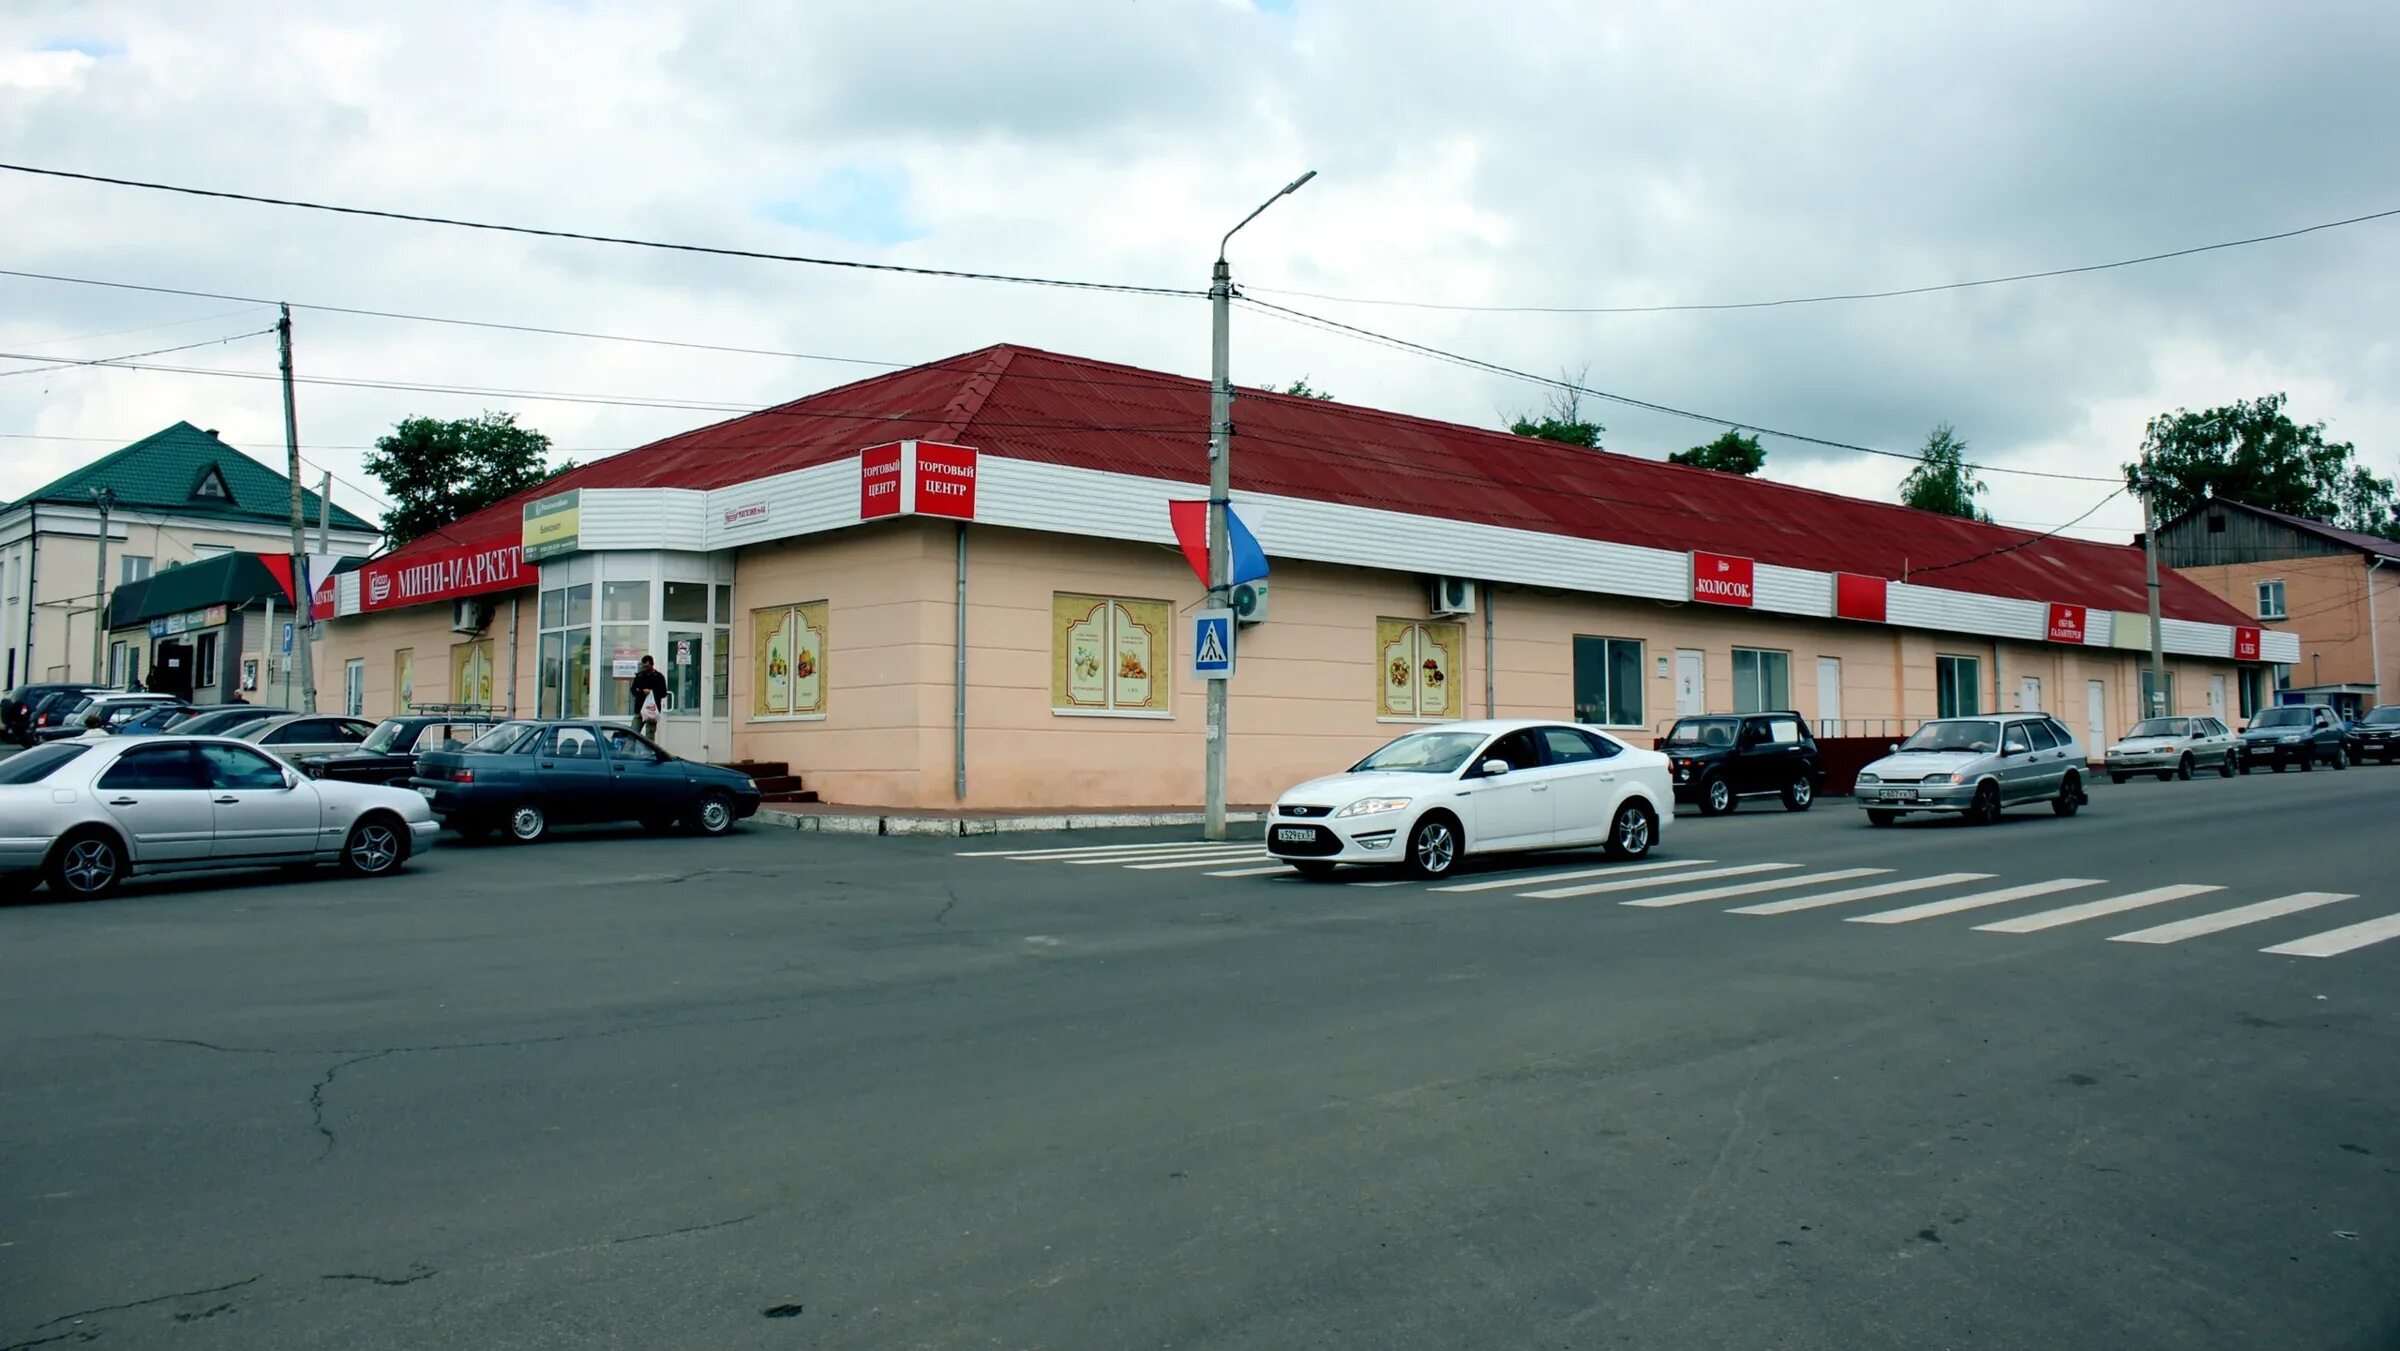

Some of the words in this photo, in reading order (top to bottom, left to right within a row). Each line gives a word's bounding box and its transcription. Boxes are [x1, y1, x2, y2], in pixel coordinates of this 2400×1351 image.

[863, 459, 900, 478] ТОРГОВЫЙ
[918, 460, 975, 478] ТОРГОВЫЙ
[868, 480, 897, 497] ЦЕНТР
[925, 480, 967, 496] ЦЕНТР
[397, 546, 520, 600] МИНИ-МАРКЕТ
[283, 625, 292, 650] P
[2240, 642, 2256, 655] ХЛЕБ
